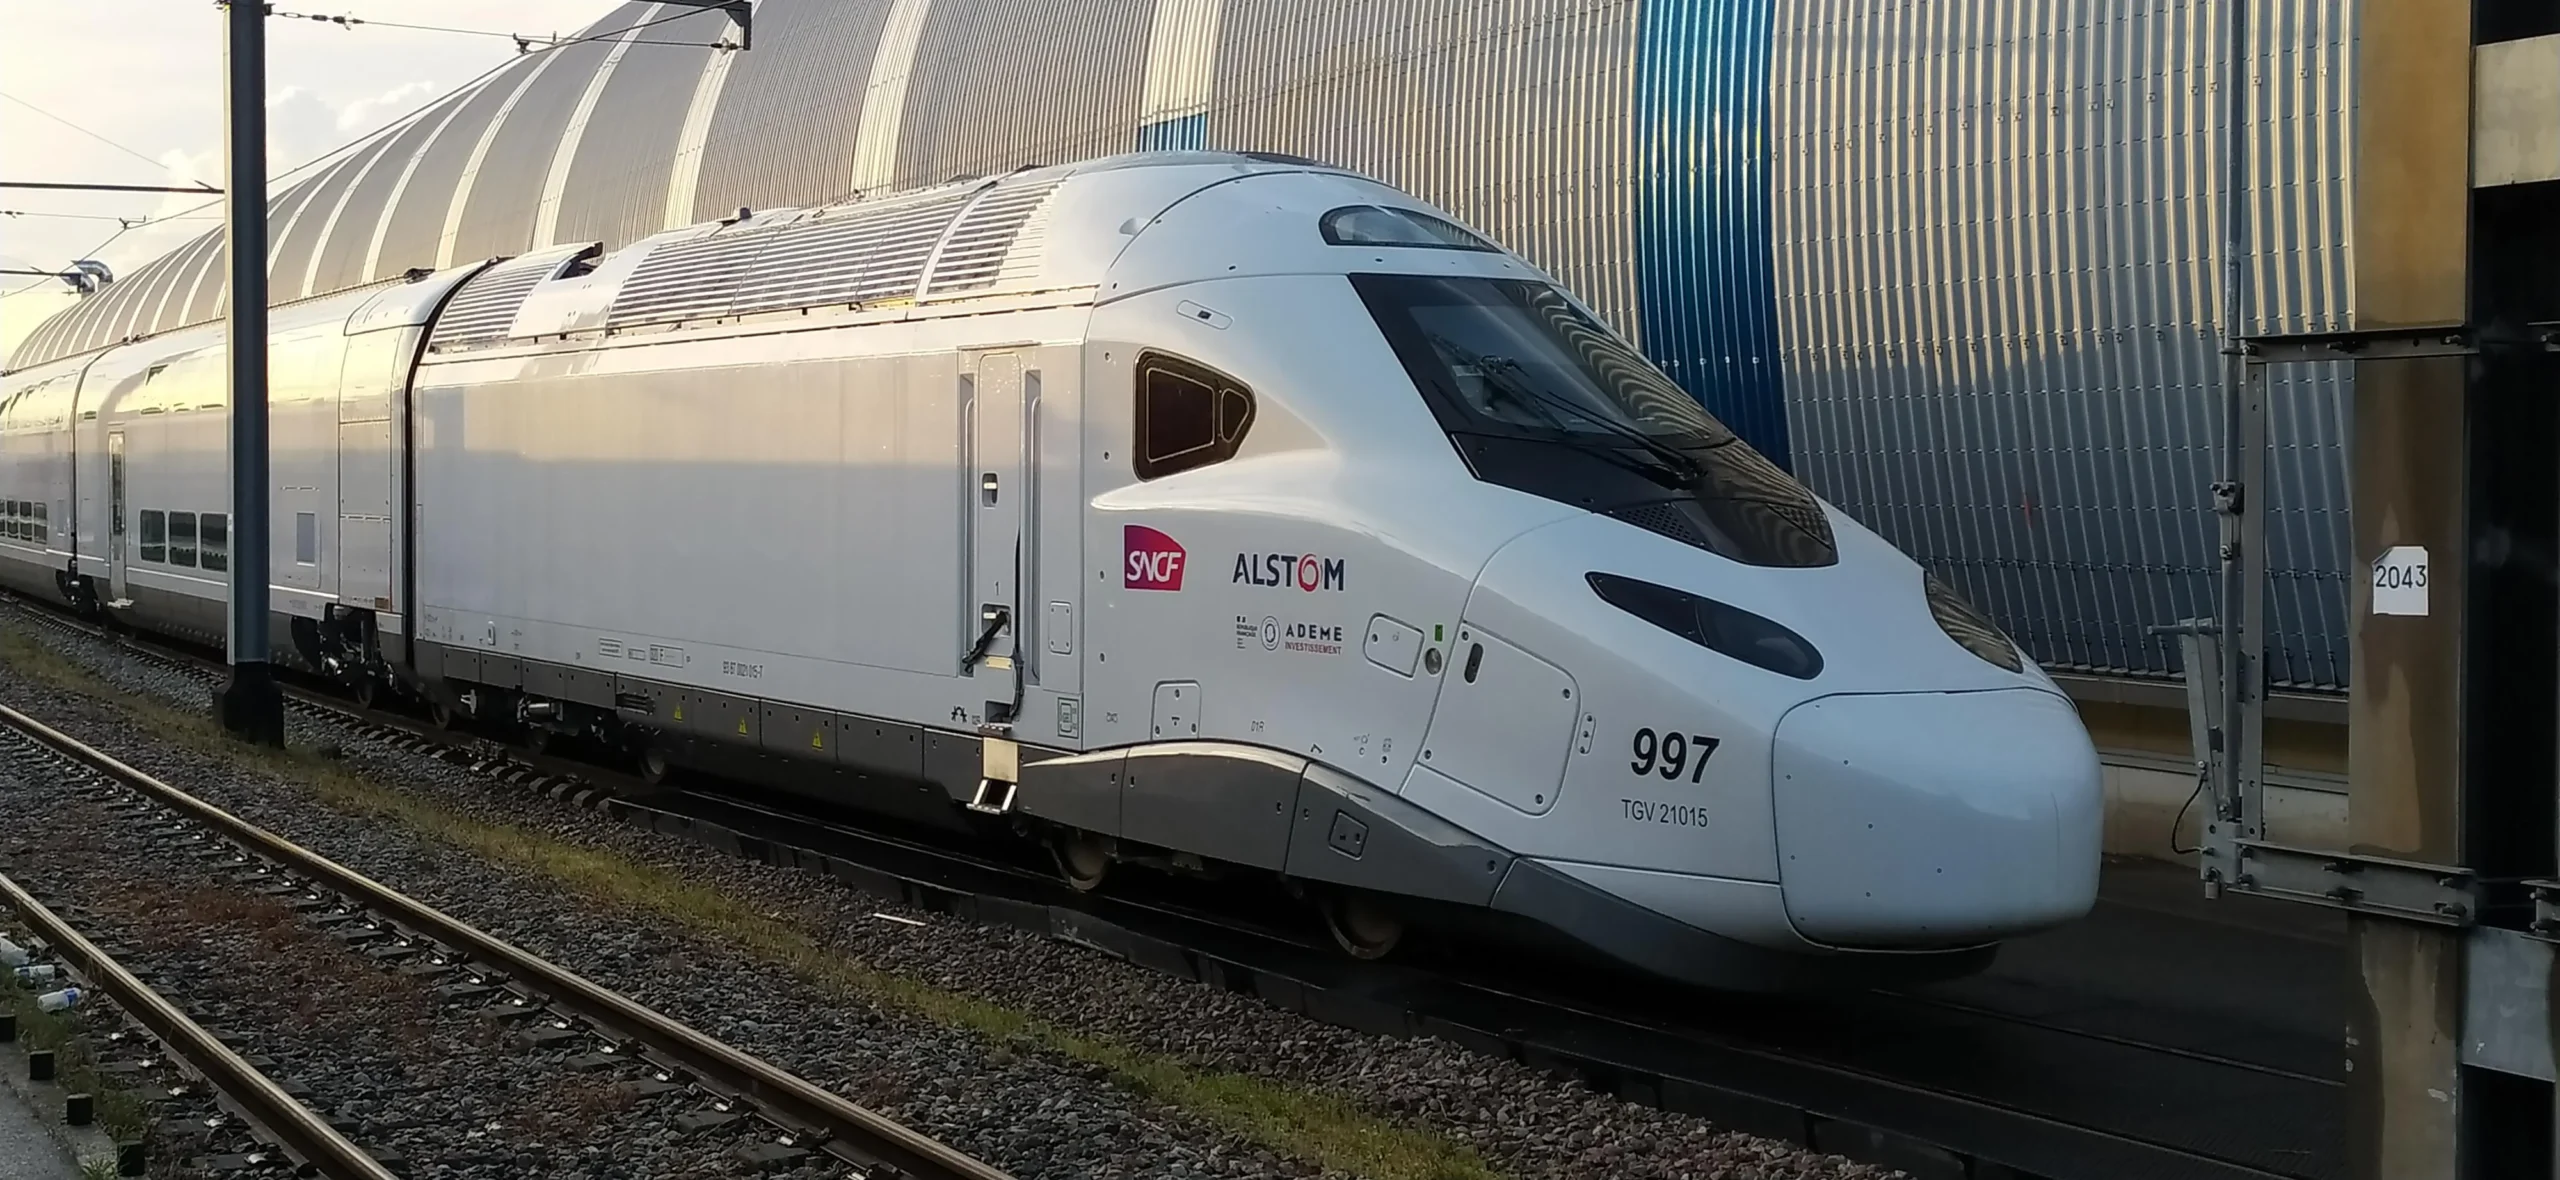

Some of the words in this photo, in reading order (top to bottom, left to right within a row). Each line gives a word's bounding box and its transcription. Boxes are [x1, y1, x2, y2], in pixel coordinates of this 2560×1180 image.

[1126, 550, 1182, 583] SNCF
[1232, 552, 1345, 593] ALSTOM
[2375, 564, 2427, 589] 2043
[1285, 623, 1343, 642] ADEME
[1284, 641, 1342, 655] INVESTISSEMENT
[1630, 727, 1720, 784] 997
[1621, 798, 1656, 822] TGV
[1660, 803, 1708, 828] 21015
